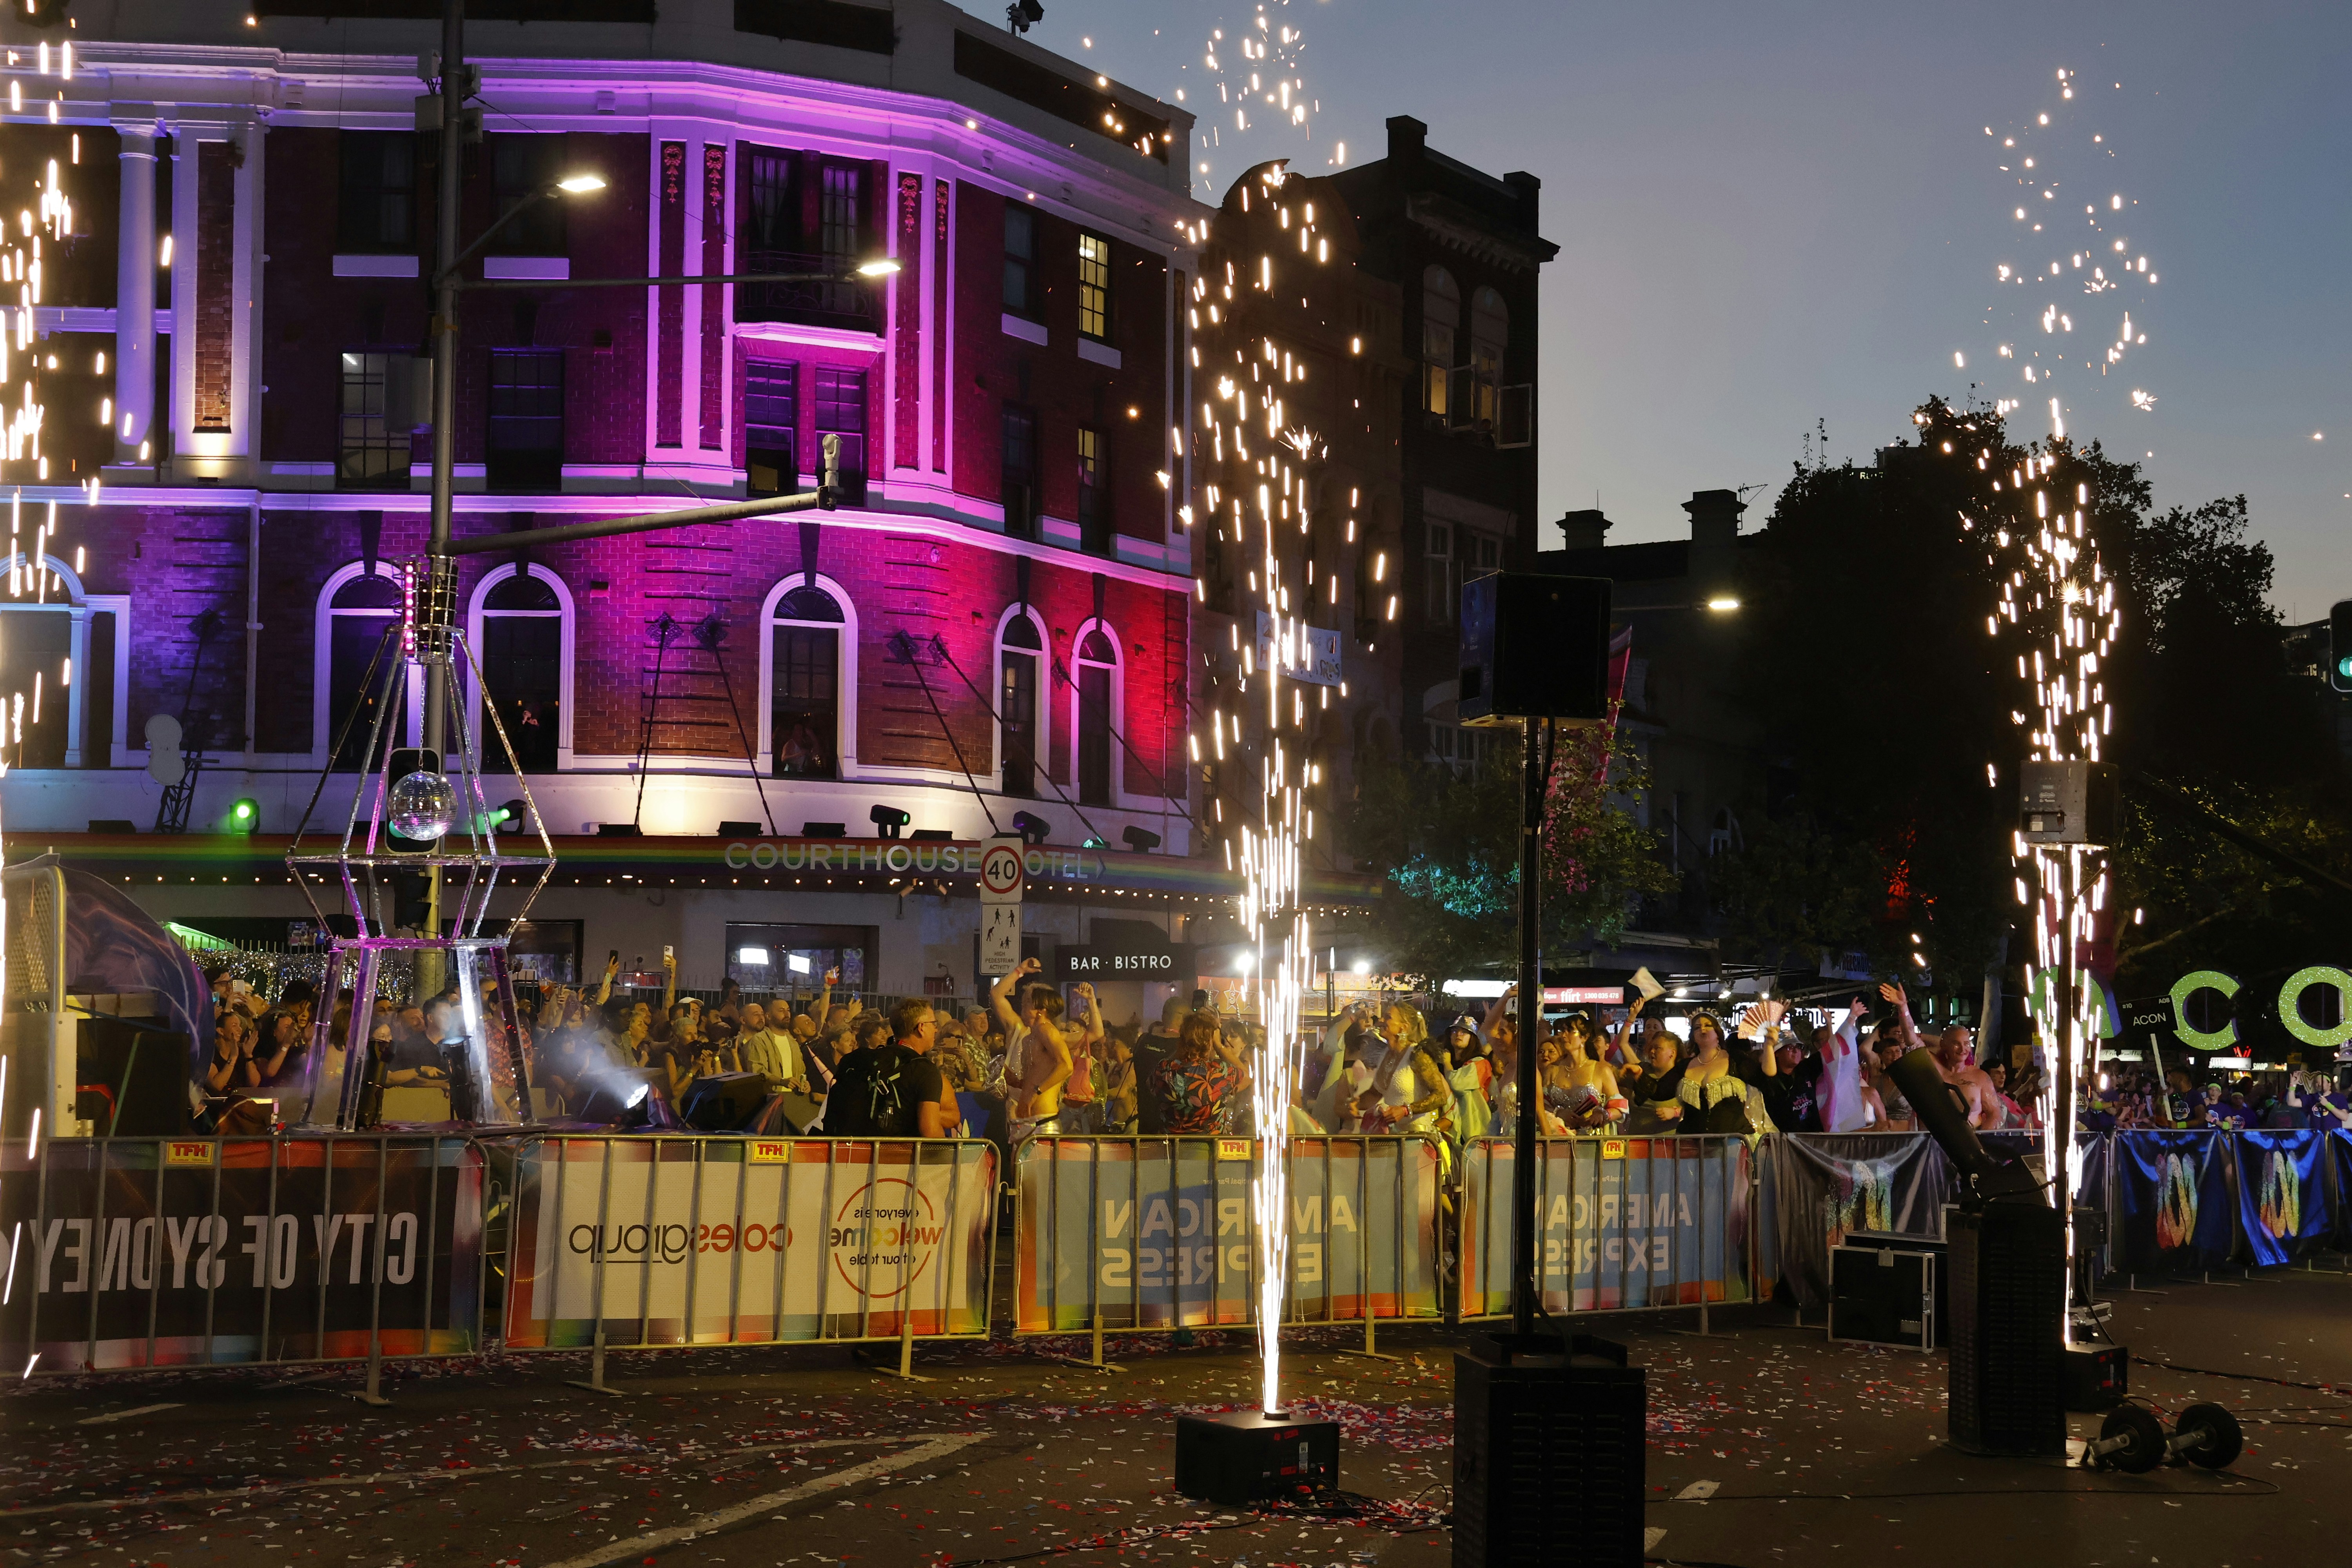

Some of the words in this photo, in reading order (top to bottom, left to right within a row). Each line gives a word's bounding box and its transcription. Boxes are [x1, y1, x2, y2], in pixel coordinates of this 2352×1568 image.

[724, 842, 980, 873] COURTHOUSE
[1024, 849, 1088, 878] OTEL
[987, 860, 1016, 880] 40
[1071, 957, 1100, 970] BAR
[1115, 955, 1171, 969] BISTRO
[1544, 992, 1557, 1000] tique
[1561, 989, 1581, 1003] flirt
[2133, 1013, 2167, 1026] ACON
[2252, 1062, 2269, 1071] SHOP
[1792, 1100, 1813, 1111] ALWAYS
[172, 1144, 205, 1156] TFH
[757, 1144, 782, 1155] TFH
[1222, 1142, 1245, 1152] TFH
